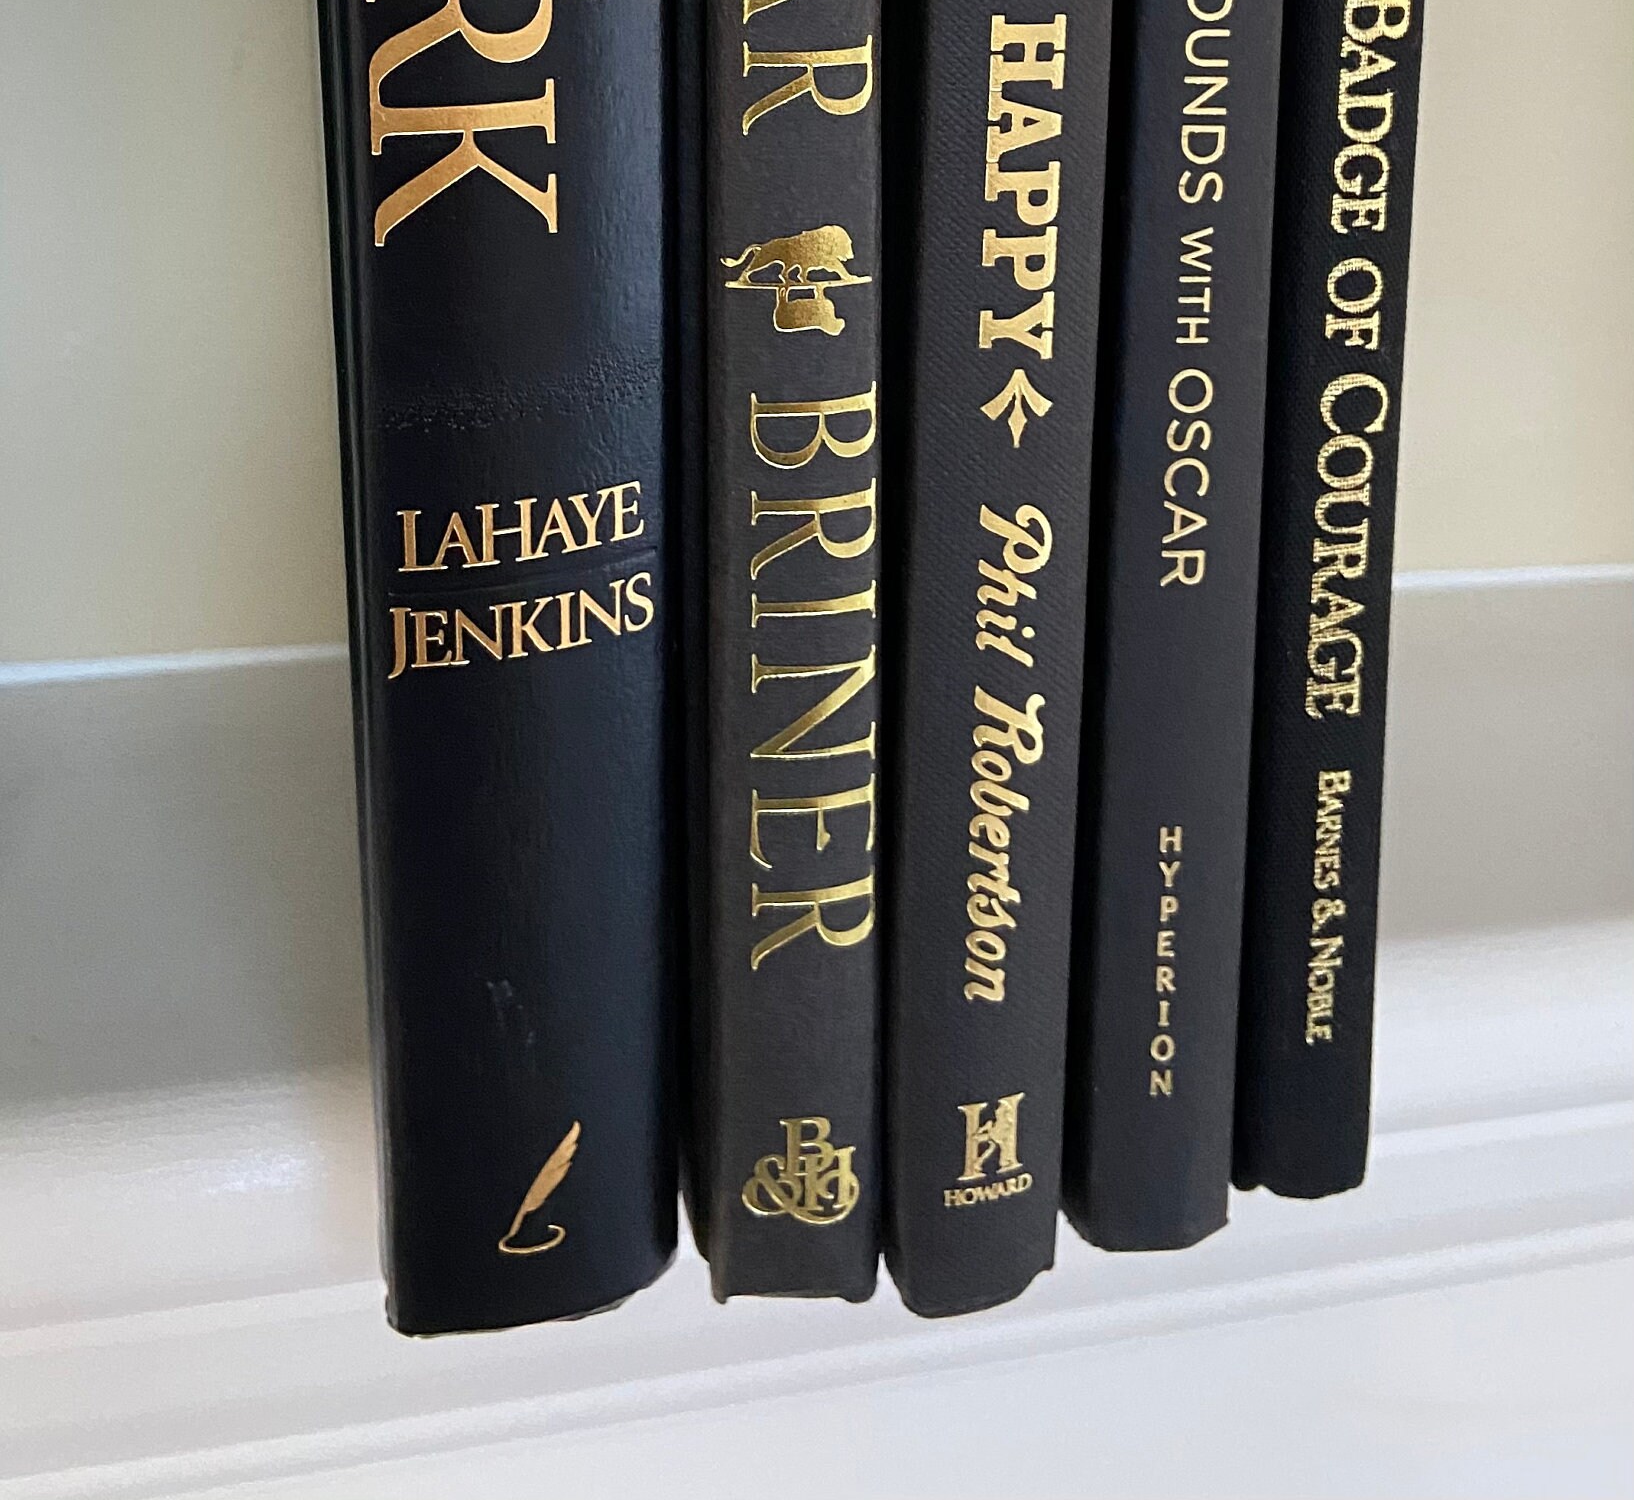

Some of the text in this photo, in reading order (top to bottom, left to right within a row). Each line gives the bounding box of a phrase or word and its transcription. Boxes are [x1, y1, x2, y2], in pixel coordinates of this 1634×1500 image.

[979, 14, 1068, 361] HAPPY
[1175, 226, 1214, 344] WITH
[1324, 257, 1384, 351] OF
[397, 481, 646, 573] LAHAYE
[1159, 368, 1214, 588] OSCAR
[1304, 373, 1390, 721] COURAGE
[388, 571, 655, 680] JENKINS
[750, 380, 877, 971] BRINER
[964, 504, 1053, 1002] Phil Robertson
[1149, 825, 1183, 1098] HYPERION
[1305, 769, 1352, 1046] BARNES & NOBLE
[944, 1173, 1033, 1207] HOWARD
